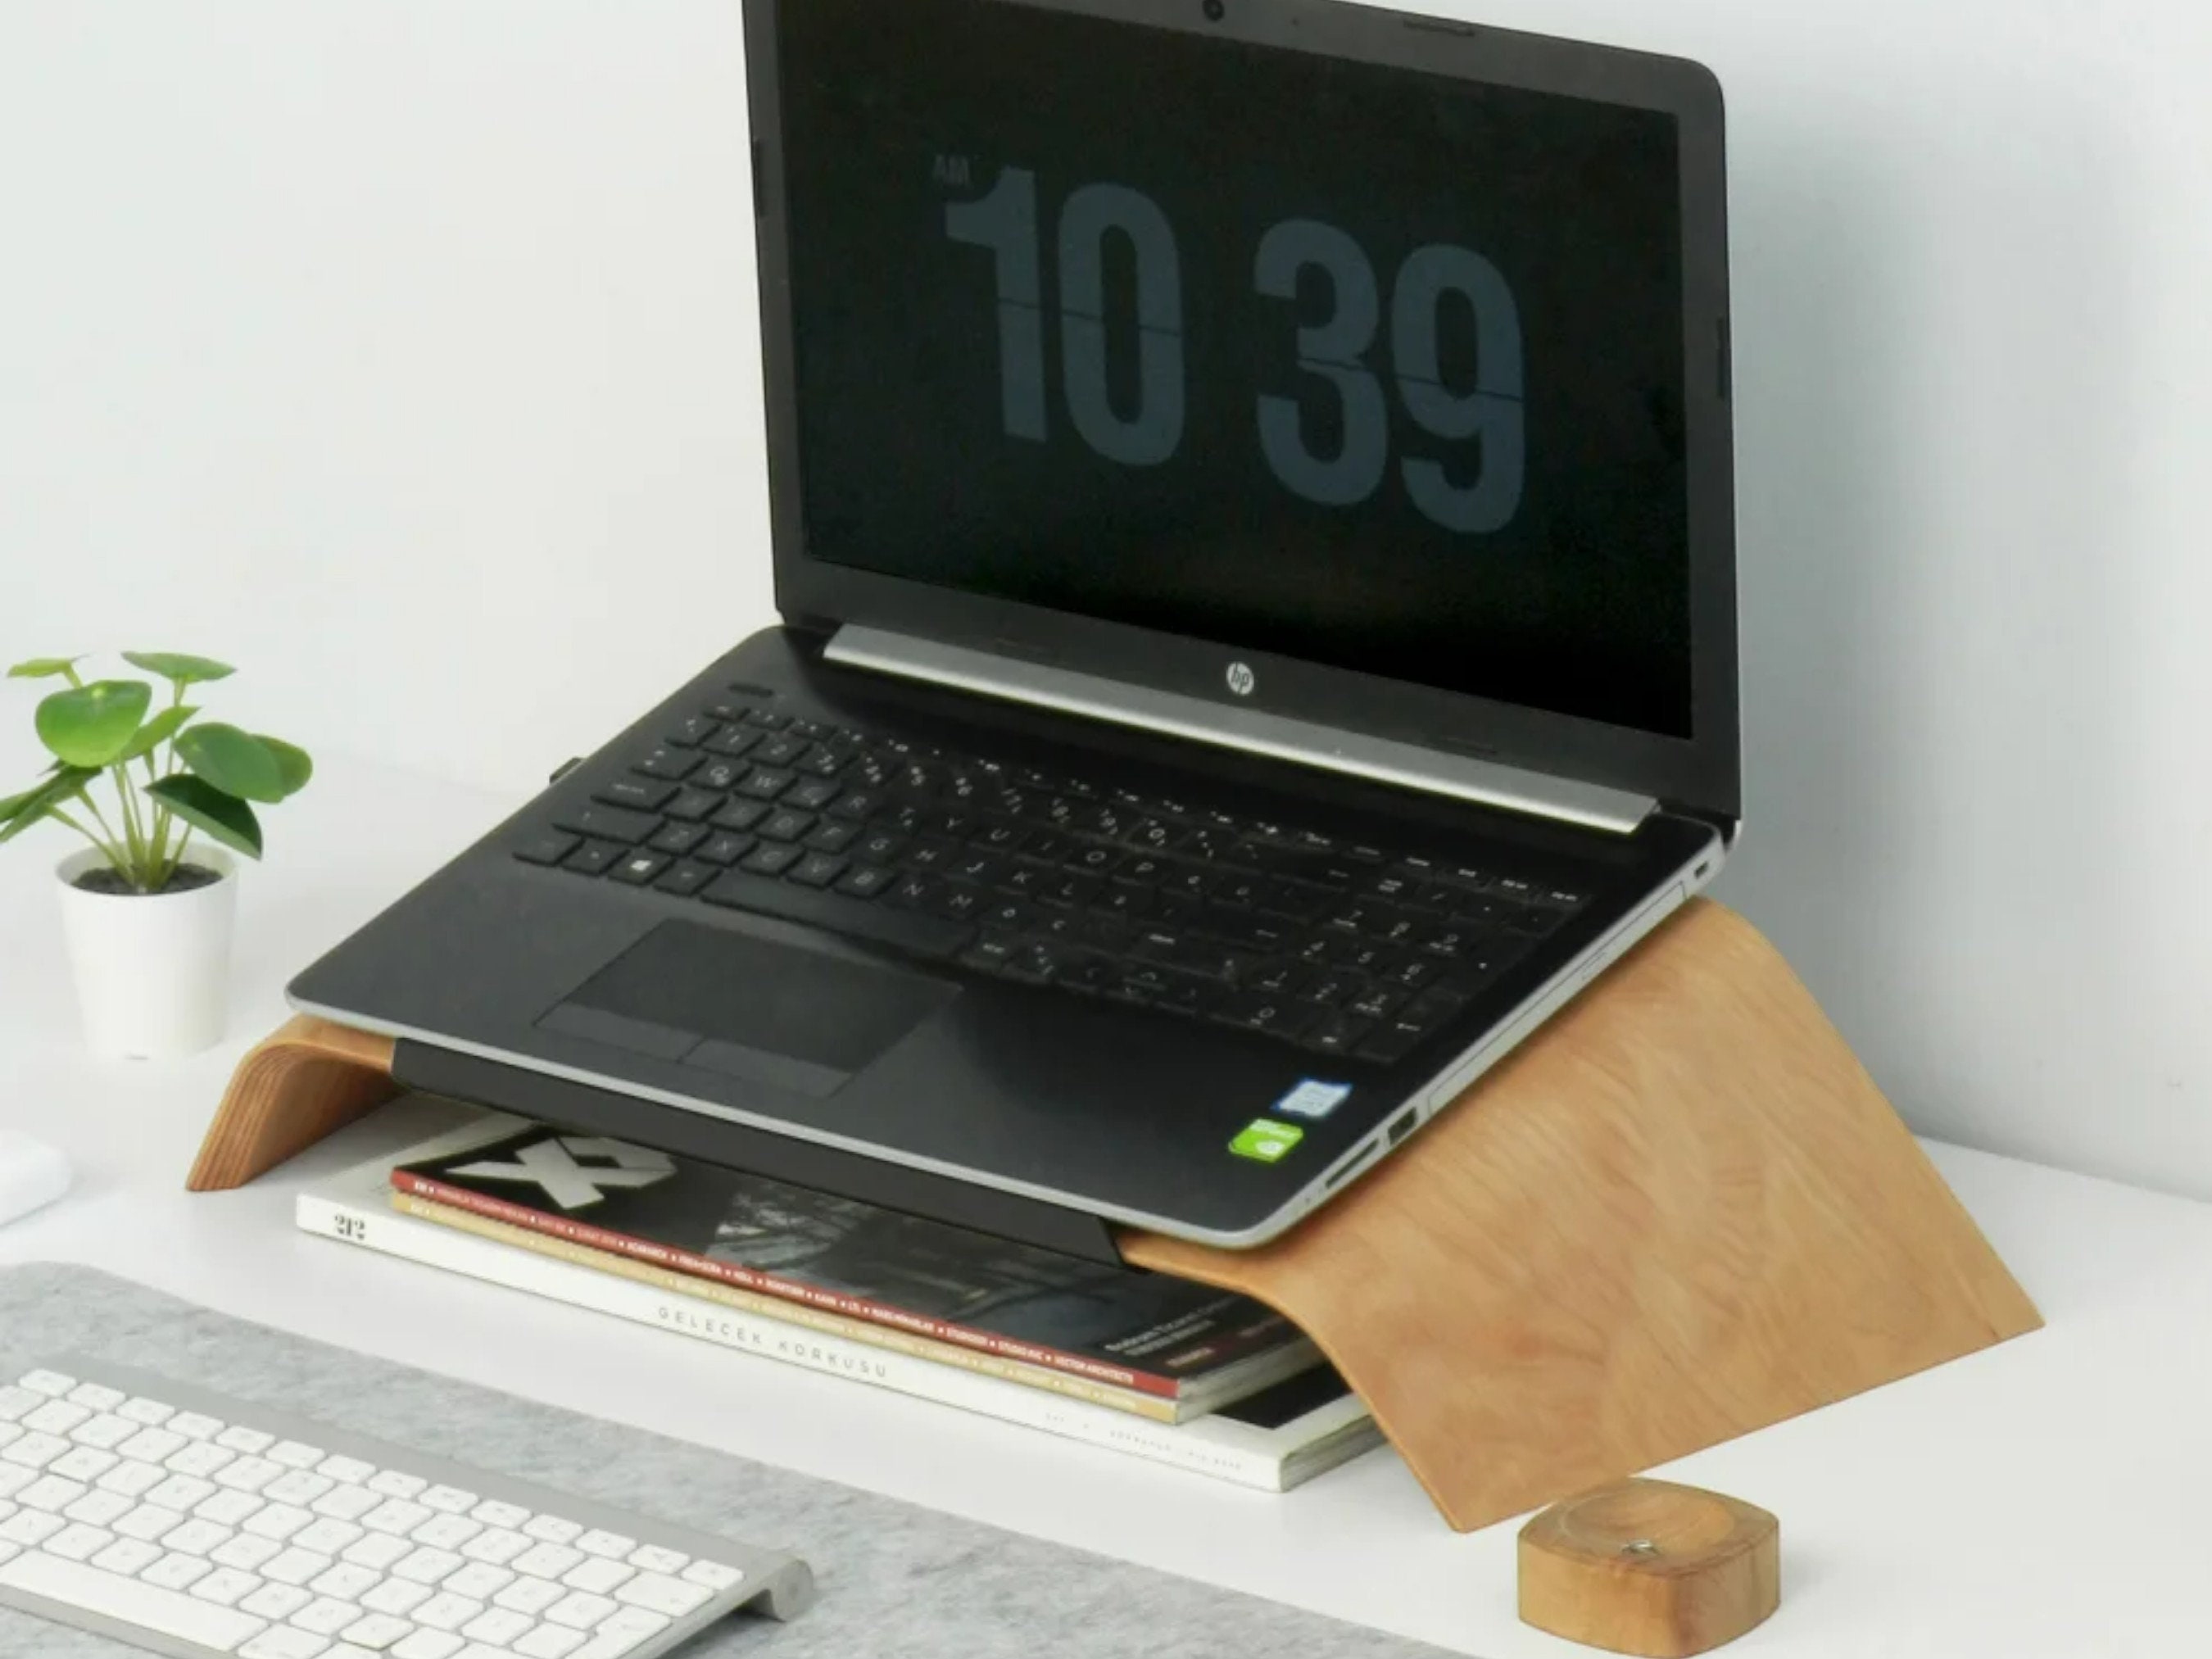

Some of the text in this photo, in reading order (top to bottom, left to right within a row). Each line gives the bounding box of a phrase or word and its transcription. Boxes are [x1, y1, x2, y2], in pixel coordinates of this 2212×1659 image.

[945, 165, 1525, 534] 10 39
[1226, 662, 1254, 696] hp
[333, 1214, 365, 1240] 212
[658, 1307, 761, 1344] GELECEK
[778, 1340, 886, 1379] KORKUSU
